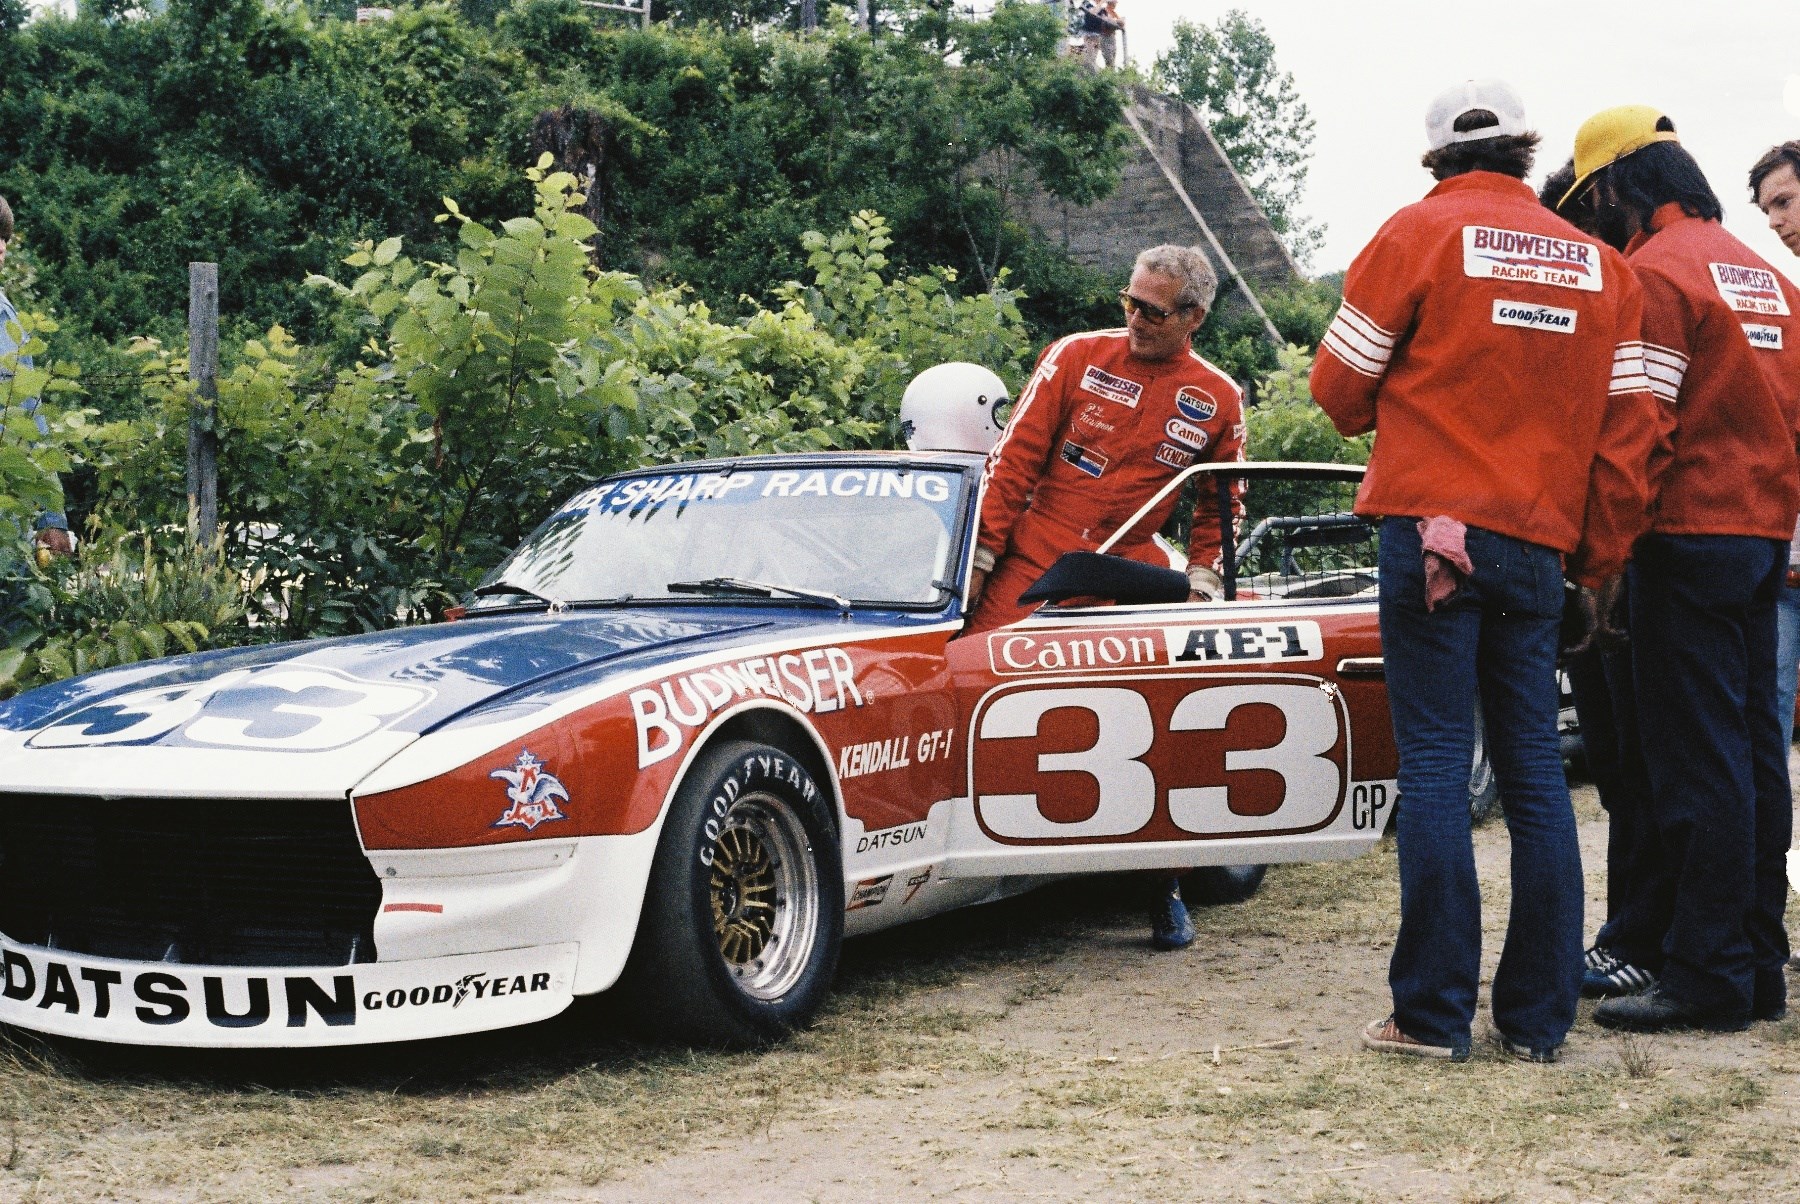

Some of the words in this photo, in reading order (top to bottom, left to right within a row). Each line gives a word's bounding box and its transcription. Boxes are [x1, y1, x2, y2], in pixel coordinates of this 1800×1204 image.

[1474, 228, 1589, 263] BUDWEISER
[1491, 265, 1538, 281] RACING
[1544, 271, 1579, 287] TEAM
[1716, 264, 1776, 291] BUDWEISER
[1736, 299, 1758, 311] RACING
[1759, 302, 1779, 313] TEAM
[1086, 367, 1142, 395] BUDWEISER
[1089, 385, 1110, 399] RACING
[1111, 393, 1130, 404] TEAM
[1179, 393, 1215, 414] DATSUN
[1168, 421, 1206, 447] Canon
[562, 484, 616, 513] OB
[611, 475, 753, 506] SHARP
[761, 471, 950, 502] RACING
[1002, 634, 1156, 669] Canon
[1175, 625, 1309, 662] AE-1
[31, 670, 425, 751] 33
[629, 646, 864, 770] BUDWEISER
[838, 742, 910, 780] KENDALL
[978, 683, 1341, 839] 33
[1352, 783, 1388, 831] CP
[856, 824, 928, 854] DATSUN
[2, 949, 357, 1029] DATSUN
